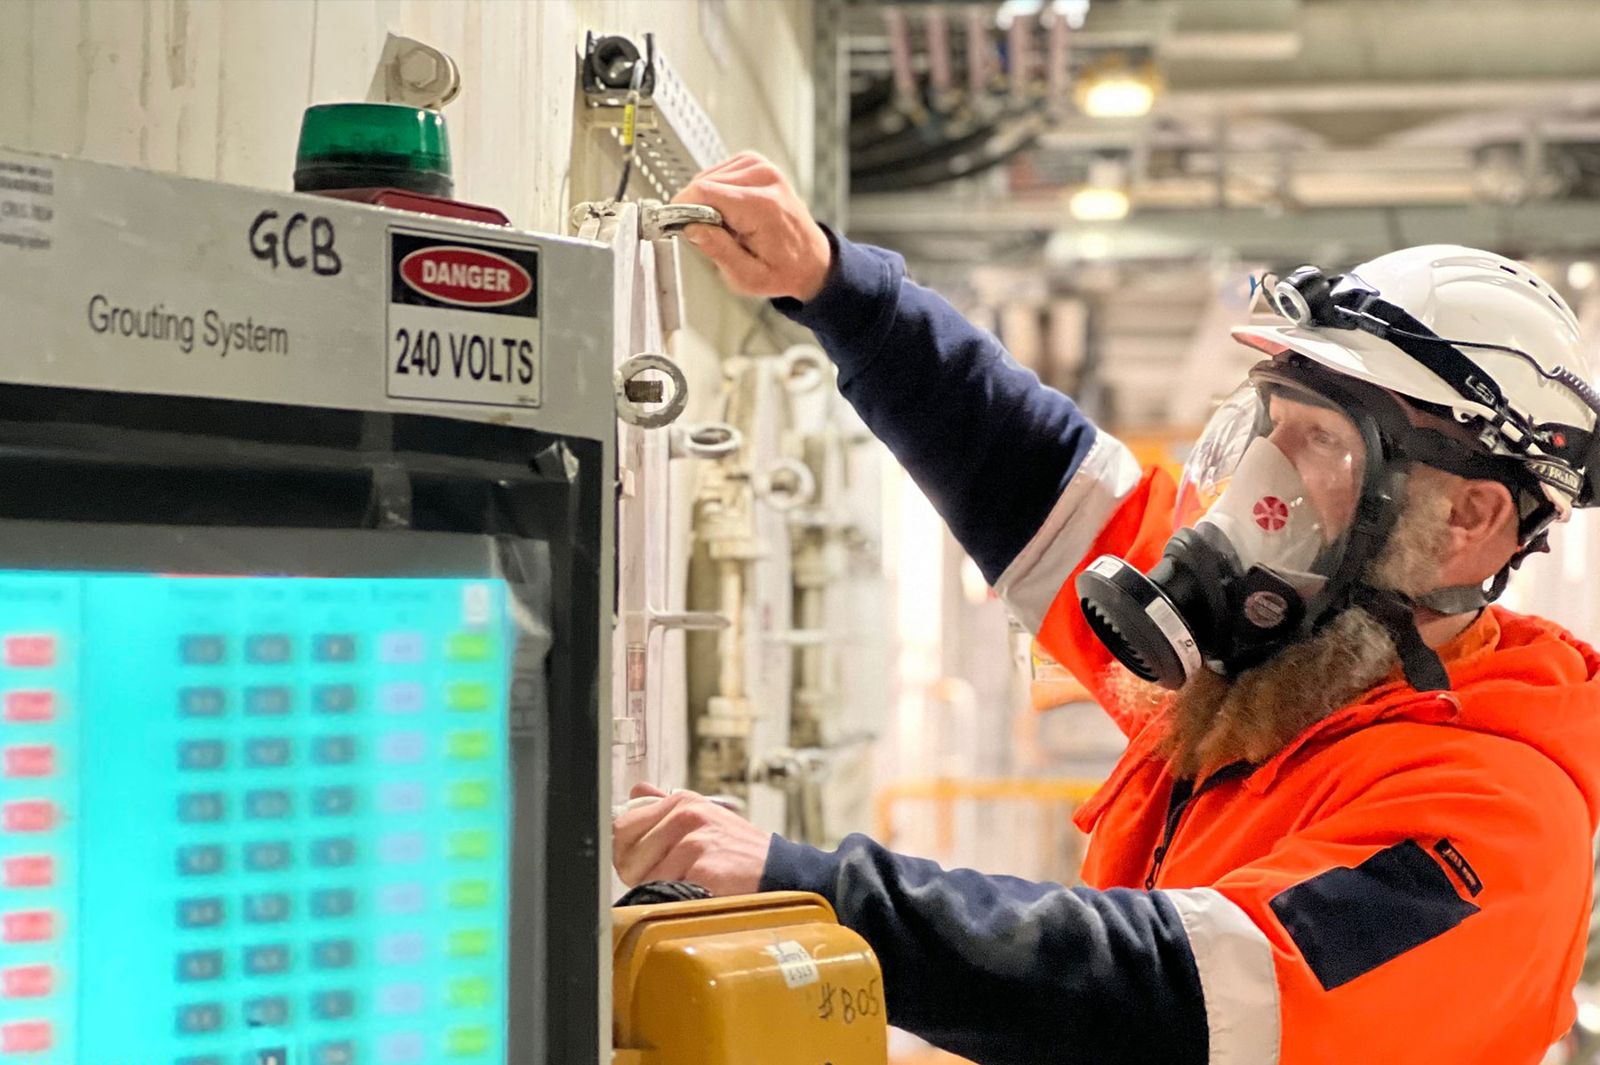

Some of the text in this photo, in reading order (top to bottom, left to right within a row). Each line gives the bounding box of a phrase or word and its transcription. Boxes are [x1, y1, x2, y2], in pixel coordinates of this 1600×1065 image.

[249, 210, 342, 276] GCB
[421, 259, 511, 292] DANGER
[88, 294, 288, 357] Grouting System
[395, 328, 533, 384] 240 VOLTS
